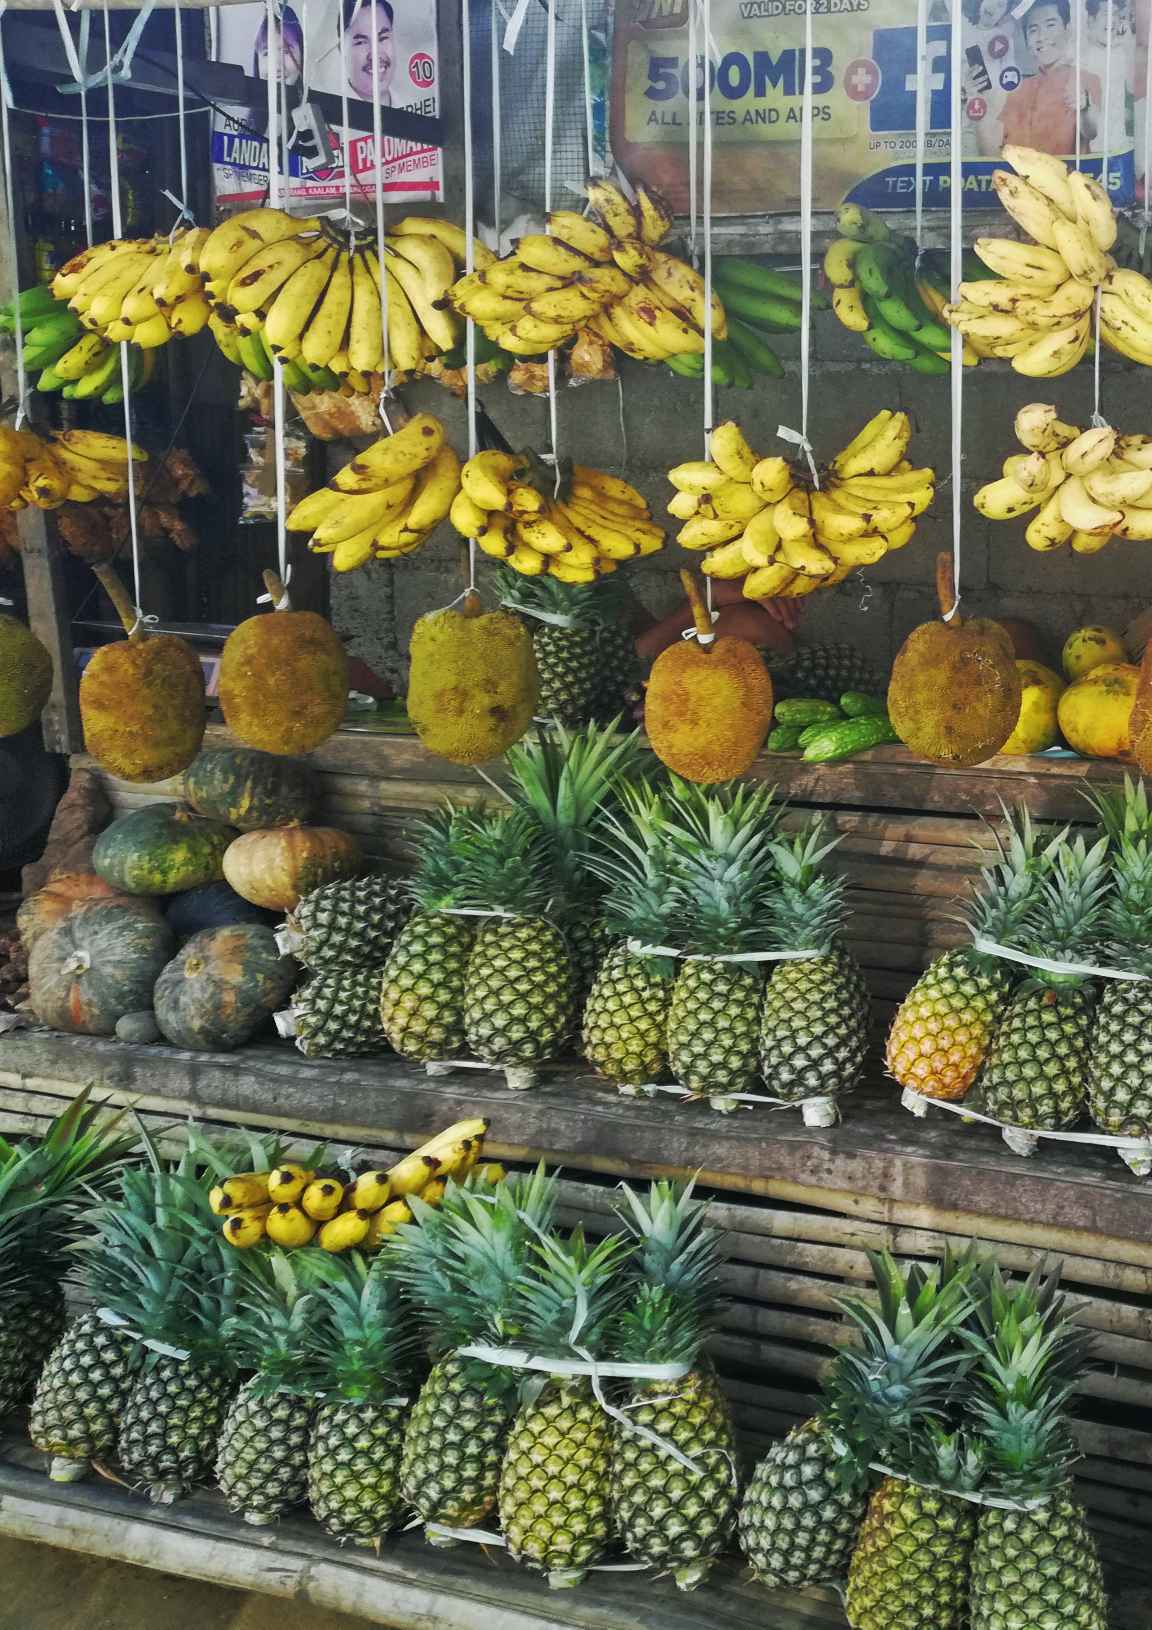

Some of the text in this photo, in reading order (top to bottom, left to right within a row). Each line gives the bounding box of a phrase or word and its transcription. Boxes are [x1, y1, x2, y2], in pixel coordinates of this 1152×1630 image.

[741, 2, 783, 18] VALID
[817, 0, 827, 13] 2
[411, 60, 433, 80] 10
[643, 47, 835, 101] 500MB
[647, 110, 683, 126] ALL
[742, 107, 780, 126] AND
[869, 141, 880, 151] UP
[883, 140, 897, 150] TO
[397, 152, 440, 176] MEMBE
